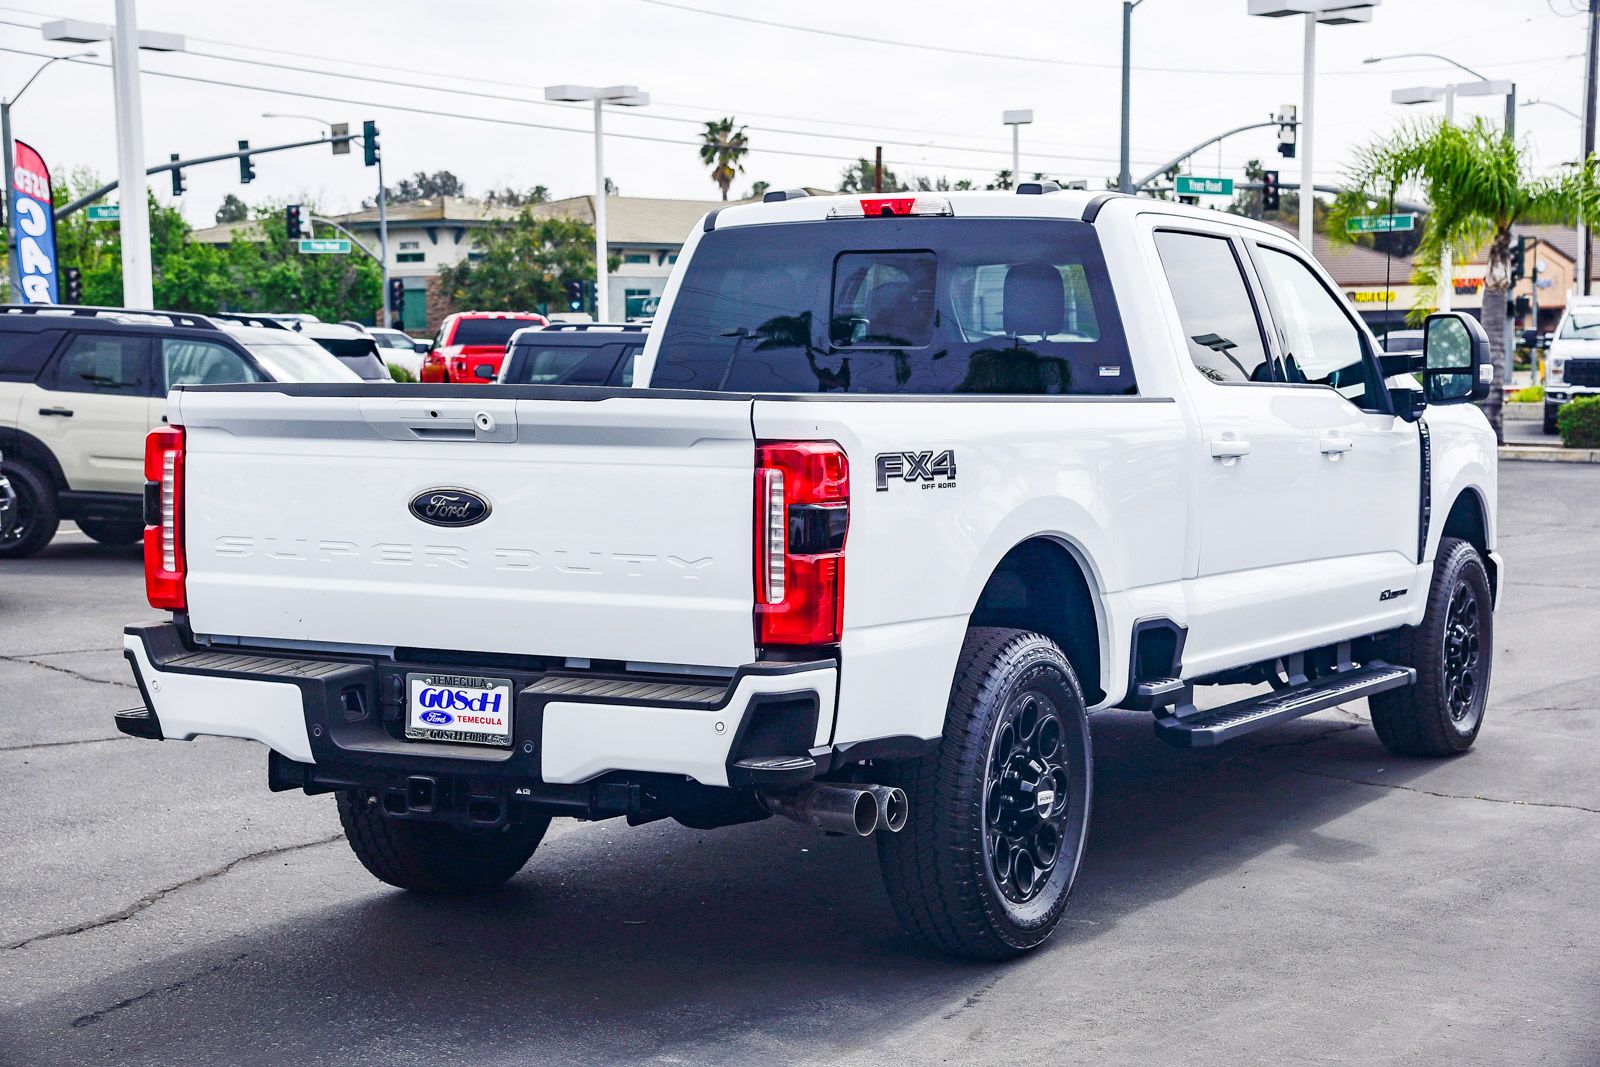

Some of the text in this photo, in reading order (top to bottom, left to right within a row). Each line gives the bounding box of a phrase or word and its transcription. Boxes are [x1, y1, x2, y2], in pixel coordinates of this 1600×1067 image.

[875, 450, 956, 492] FX4
[426, 495, 470, 518] Ford
[215, 536, 714, 579] SUPER DUTY
[431, 676, 487, 688] TEMECULA
[426, 712, 447, 724] Ford
[457, 715, 503, 726] TEMECULA
[464, 732, 488, 743] FORD
